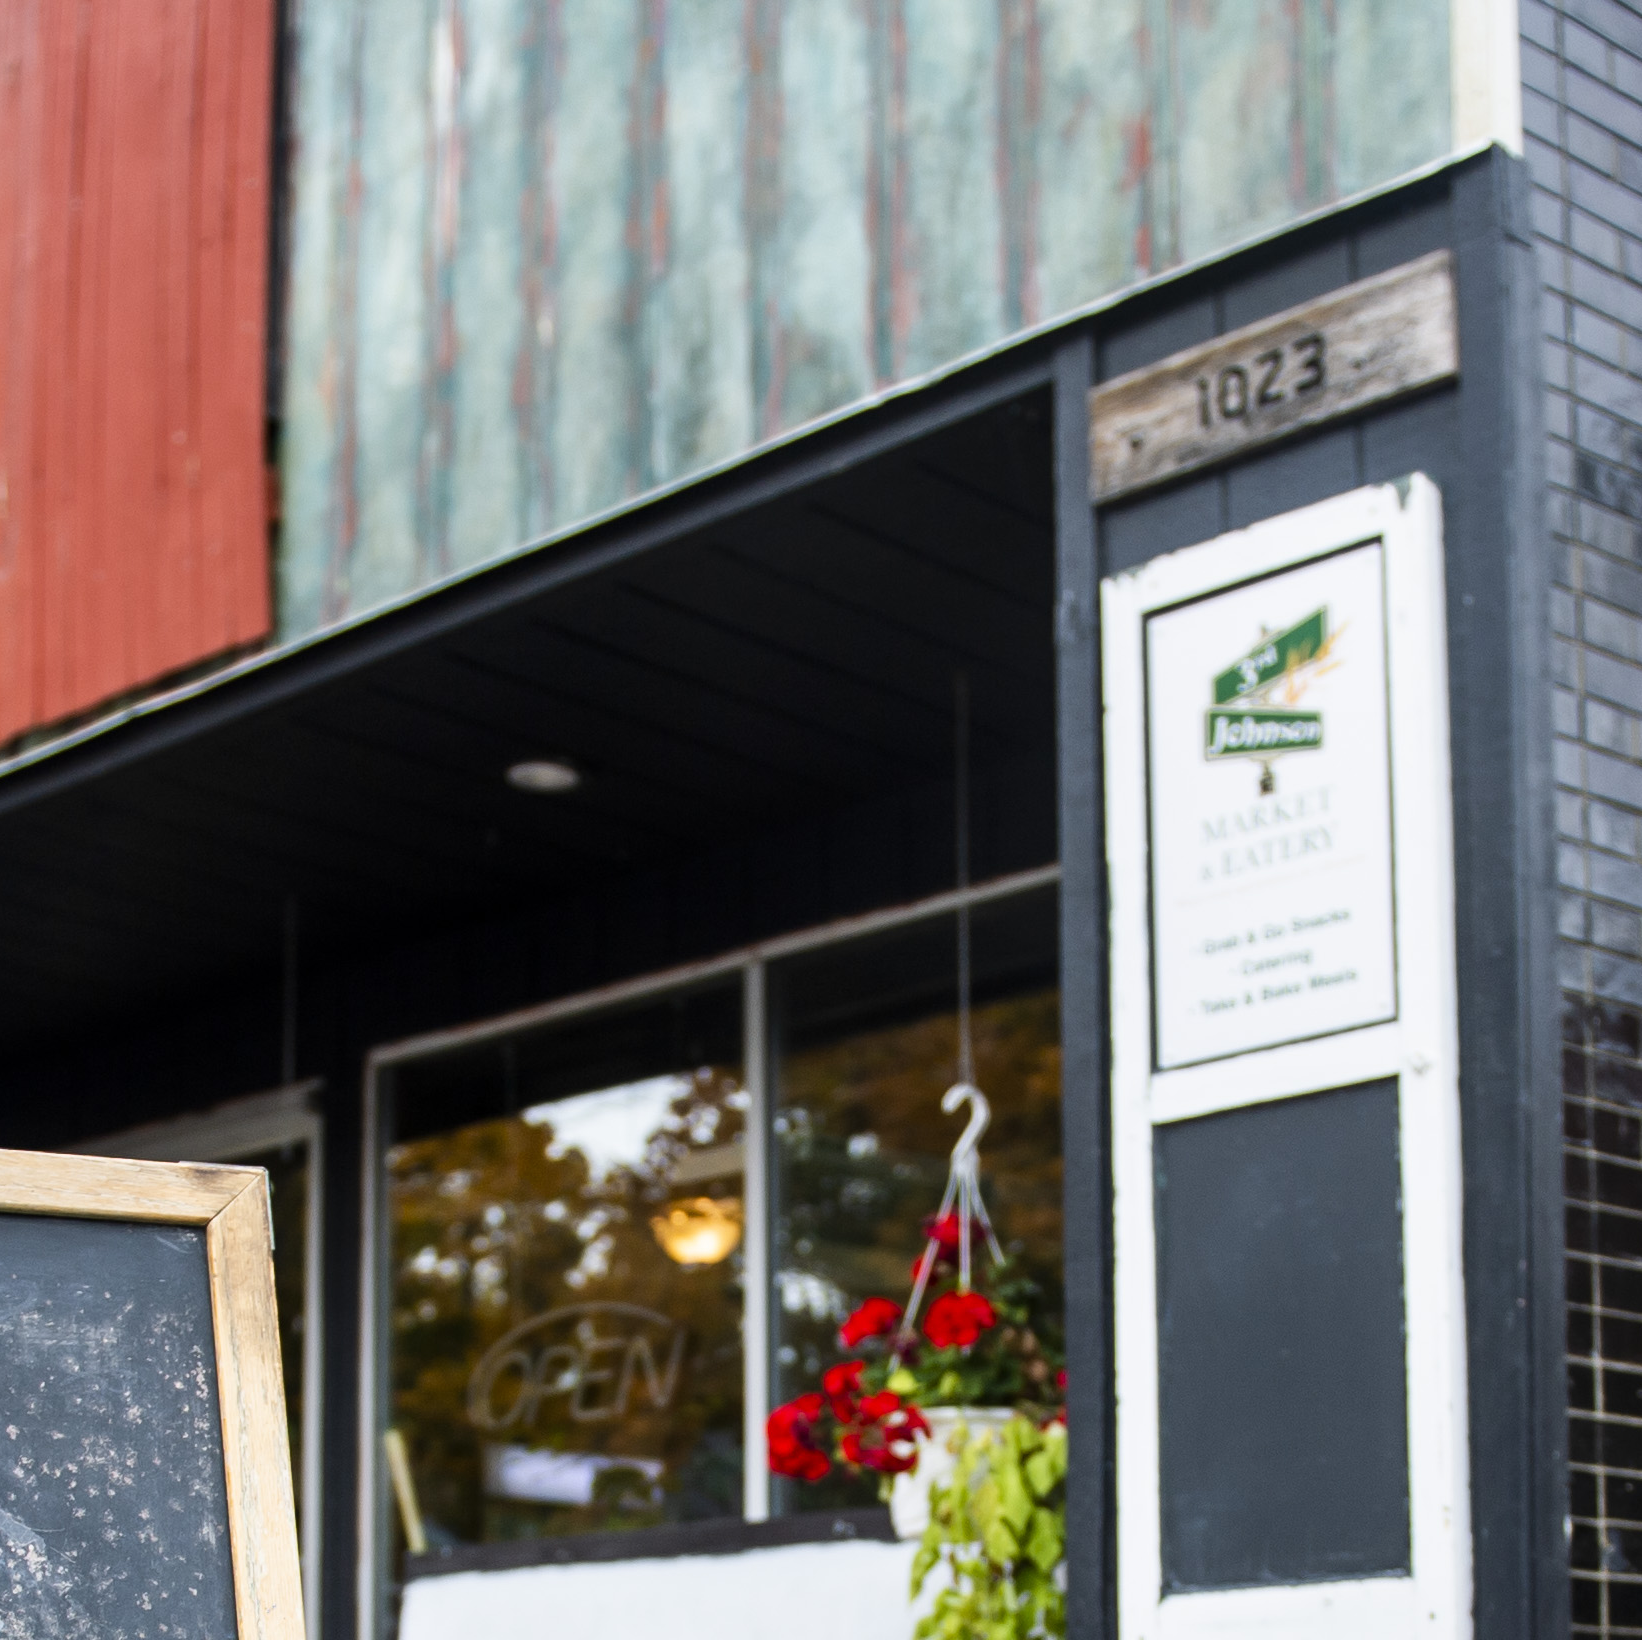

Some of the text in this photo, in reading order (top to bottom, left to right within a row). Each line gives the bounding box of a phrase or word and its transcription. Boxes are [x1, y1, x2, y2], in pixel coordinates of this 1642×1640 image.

[1197, 331, 1328, 430] 1023
[1208, 715, 1322, 755] Johnson
[1201, 783, 1337, 843] MARKET
[1220, 820, 1338, 877] EATERY
[469, 1318, 691, 1430] OPEN
